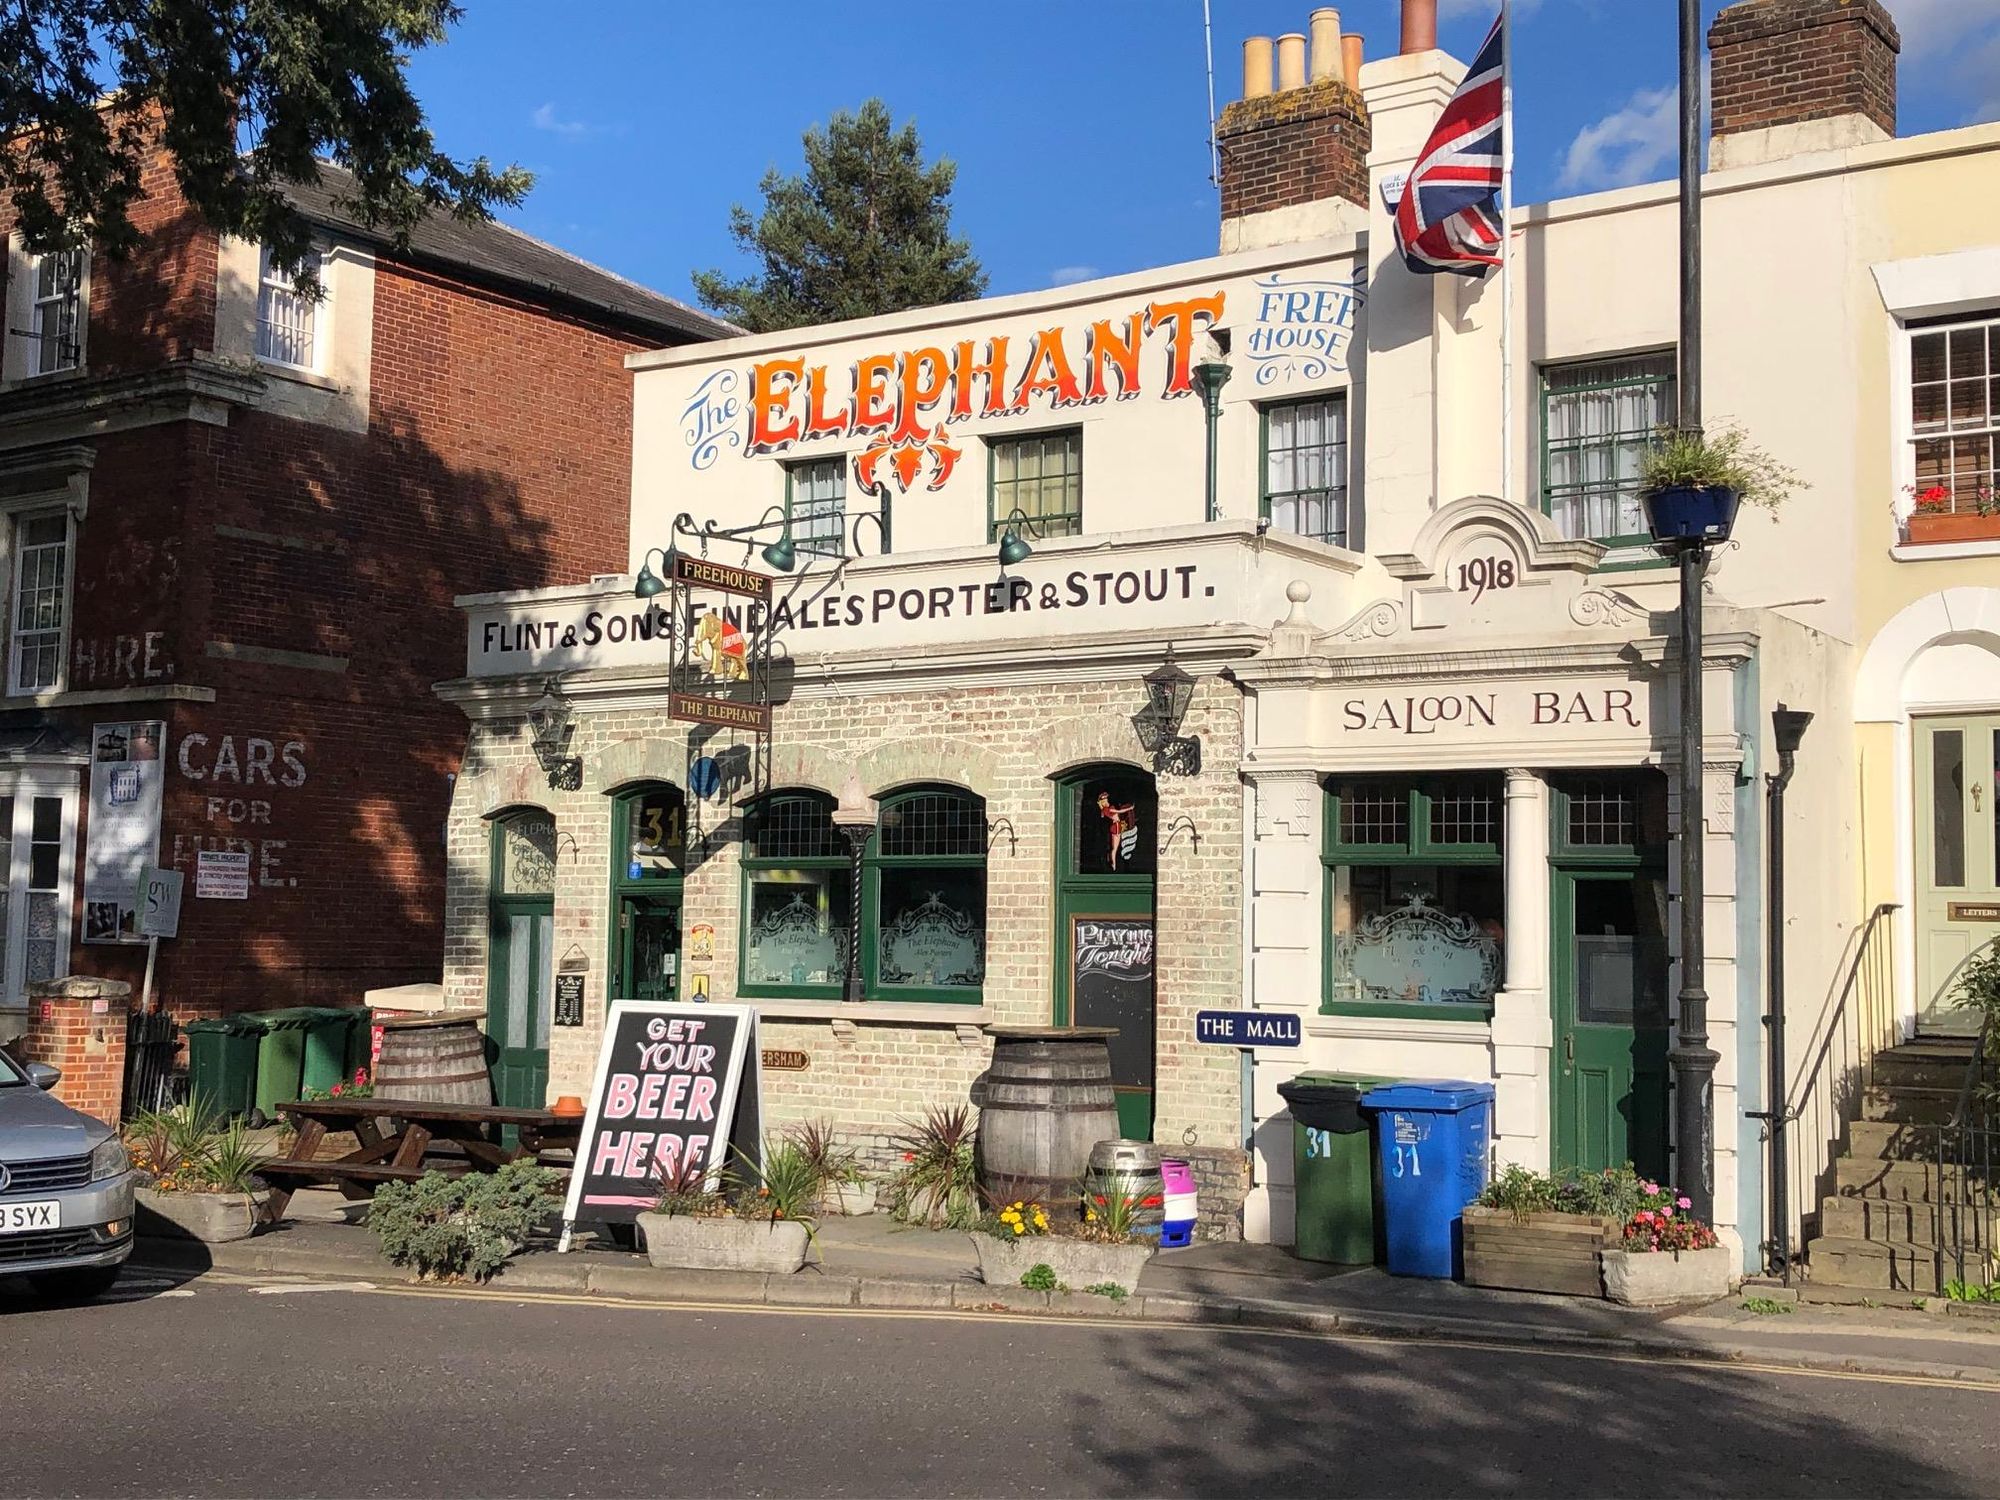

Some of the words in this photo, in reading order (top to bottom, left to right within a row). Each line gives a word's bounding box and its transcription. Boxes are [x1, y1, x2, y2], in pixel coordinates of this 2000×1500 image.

[1256, 290, 1364, 331] FREE
[1248, 327, 1348, 361] HOUSE
[680, 385, 741, 446] The
[743, 290, 1226, 458] ELEPHANT
[684, 561, 764, 593] FREEHOUSE
[1458, 556, 1515, 604] 1918
[771, 595, 865, 631] ALES
[680, 700, 703, 716] THE
[707, 704, 762, 724] ELEPHANT
[1343, 693, 1498, 734] SALOON
[1531, 689, 1641, 727] BAR
[178, 732, 307, 787] CARS
[207, 797, 271, 824] FOR
[646, 807, 681, 848] 31
[647, 1018, 706, 1043] GET
[1200, 1018, 1234, 1036] THE
[1247, 1020, 1297, 1039] MALL
[636, 1042, 716, 1073] YOUR
[603, 1073, 718, 1122] BEER
[592, 1130, 710, 1181] HERE
[1306, 1126, 1331, 1158] 31
[1391, 1144, 1421, 1178] 31
[12, 1205, 51, 1227] SYX
